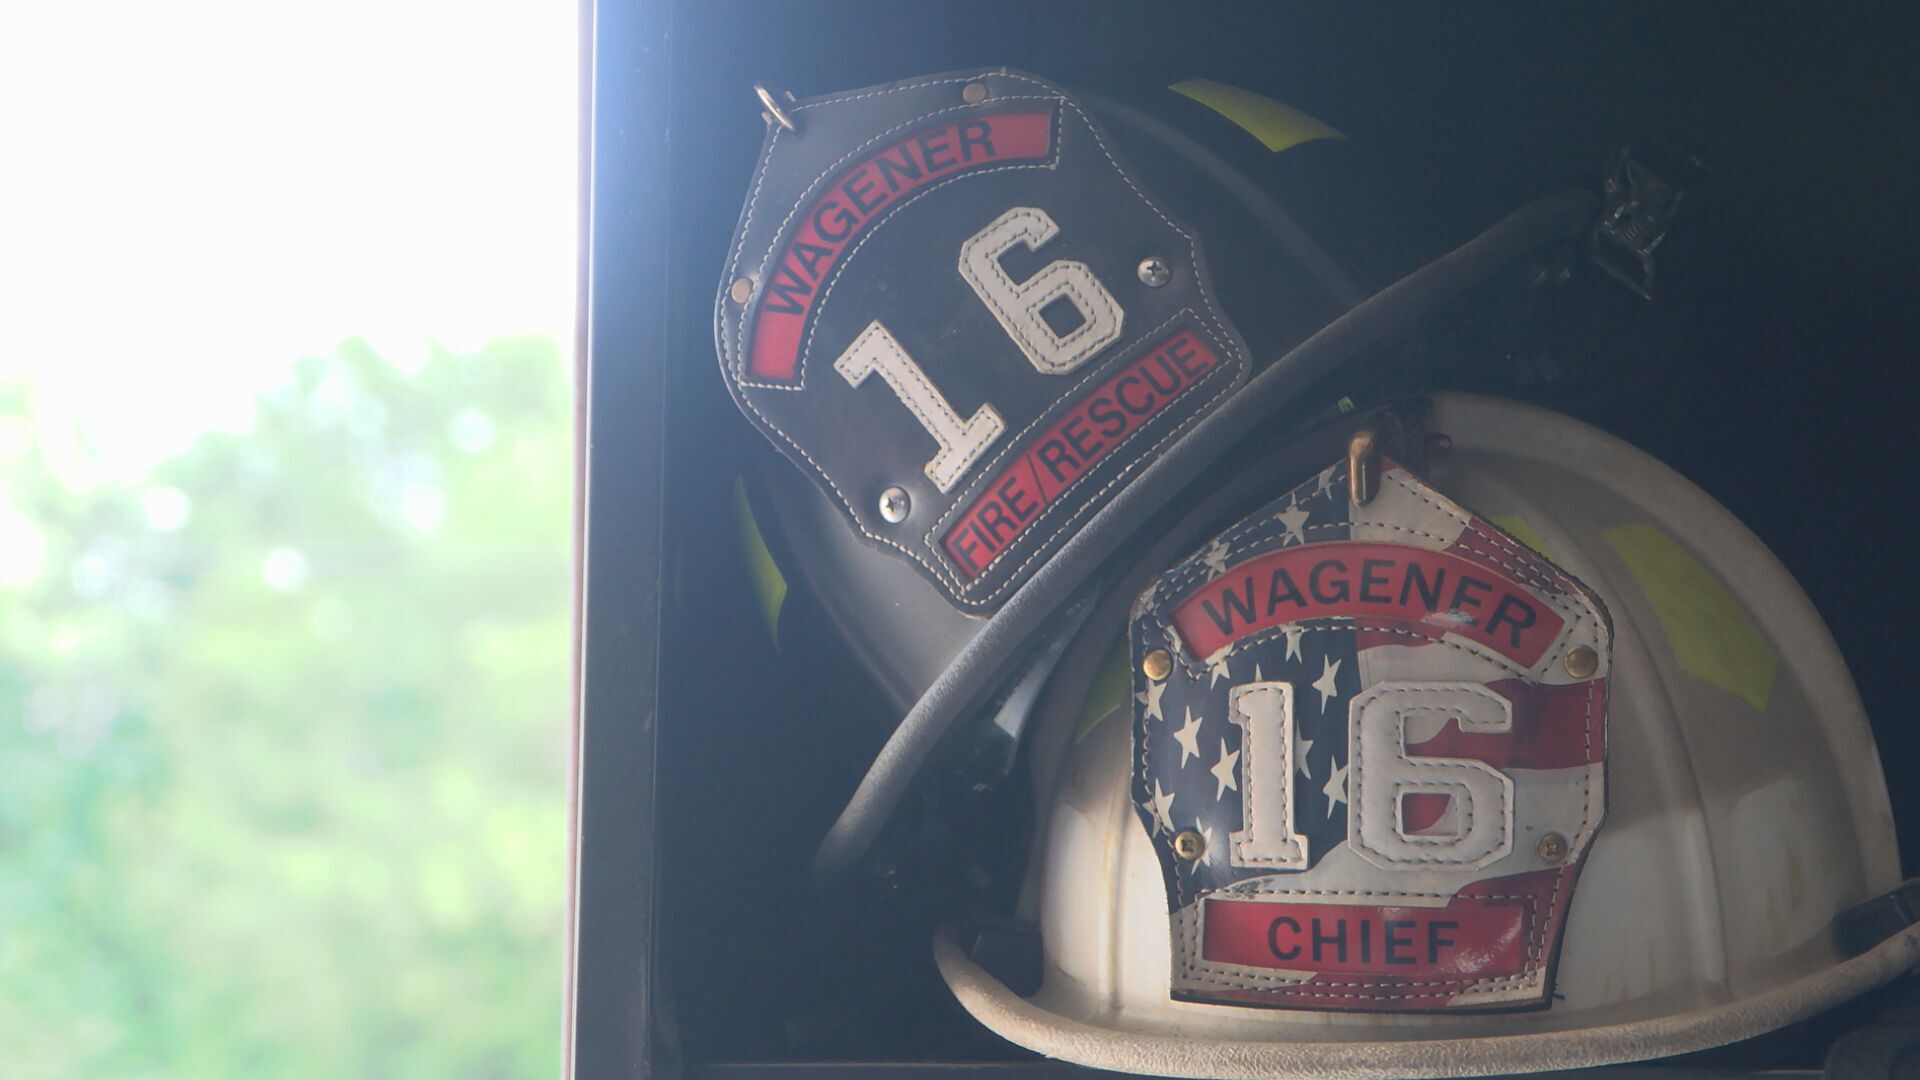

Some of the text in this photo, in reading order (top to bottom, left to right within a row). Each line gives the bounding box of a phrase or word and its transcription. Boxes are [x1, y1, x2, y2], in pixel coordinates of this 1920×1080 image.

[767, 119, 997, 318] WAGENER
[833, 206, 1125, 495] 16
[950, 336, 1209, 572] FIRE/RESCUE
[1202, 559, 1537, 649] WAGENER
[1228, 681, 1514, 871] 16
[1267, 915, 1460, 965] CHIEF
